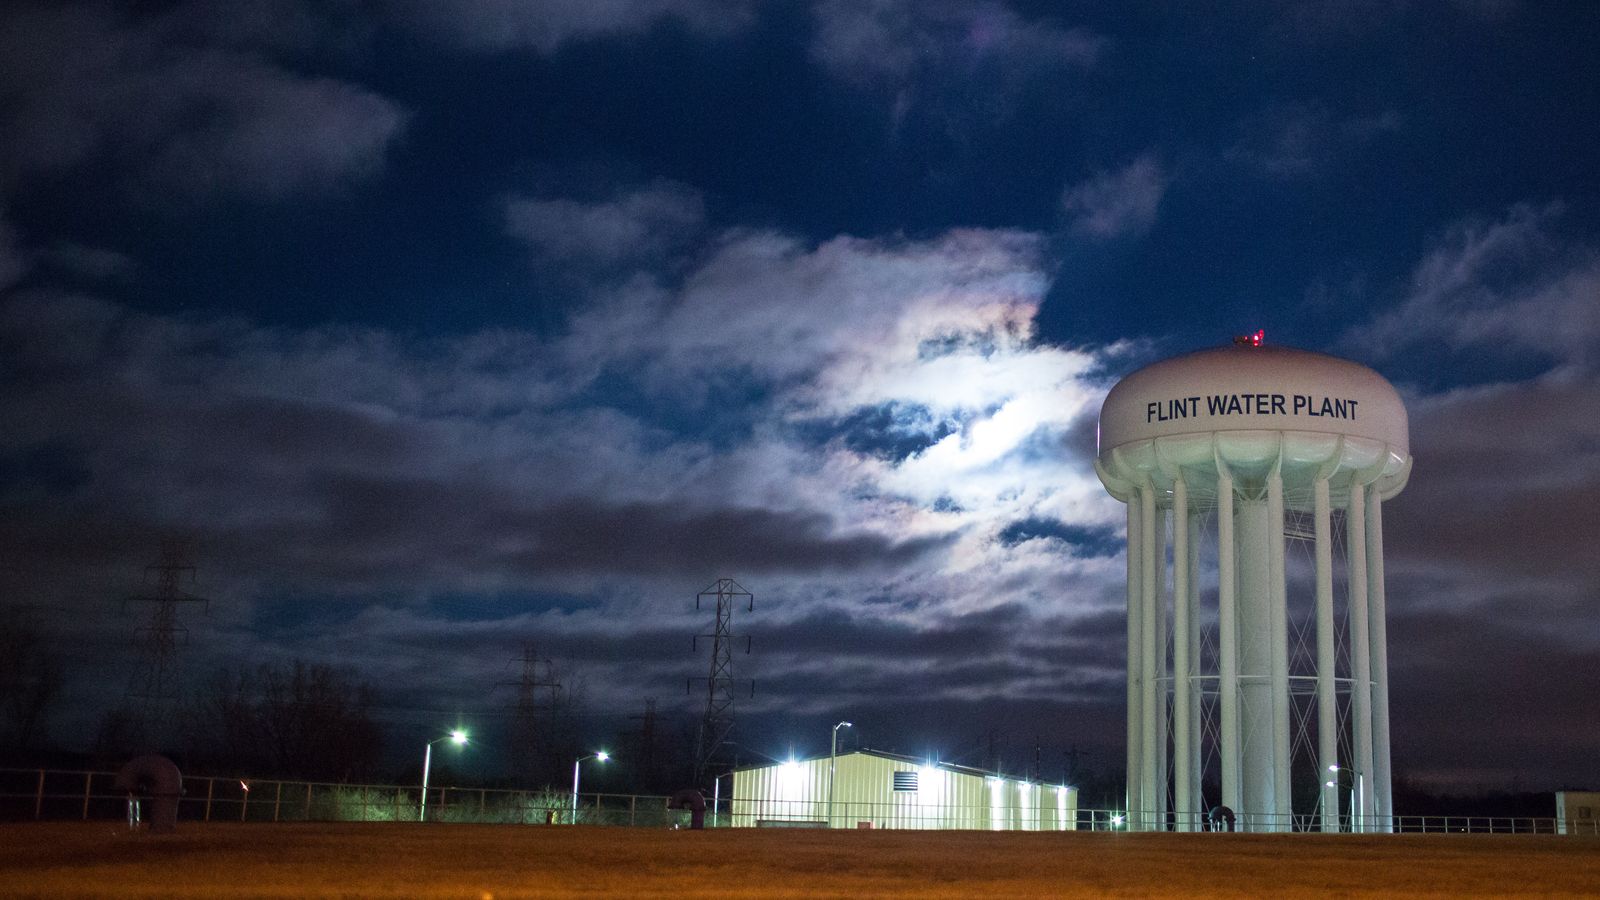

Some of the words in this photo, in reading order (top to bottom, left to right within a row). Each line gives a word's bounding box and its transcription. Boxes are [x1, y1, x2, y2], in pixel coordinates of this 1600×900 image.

[1147, 396, 1201, 423] FLINT
[1207, 393, 1287, 416] WATER
[1294, 395, 1359, 420] PLANT
